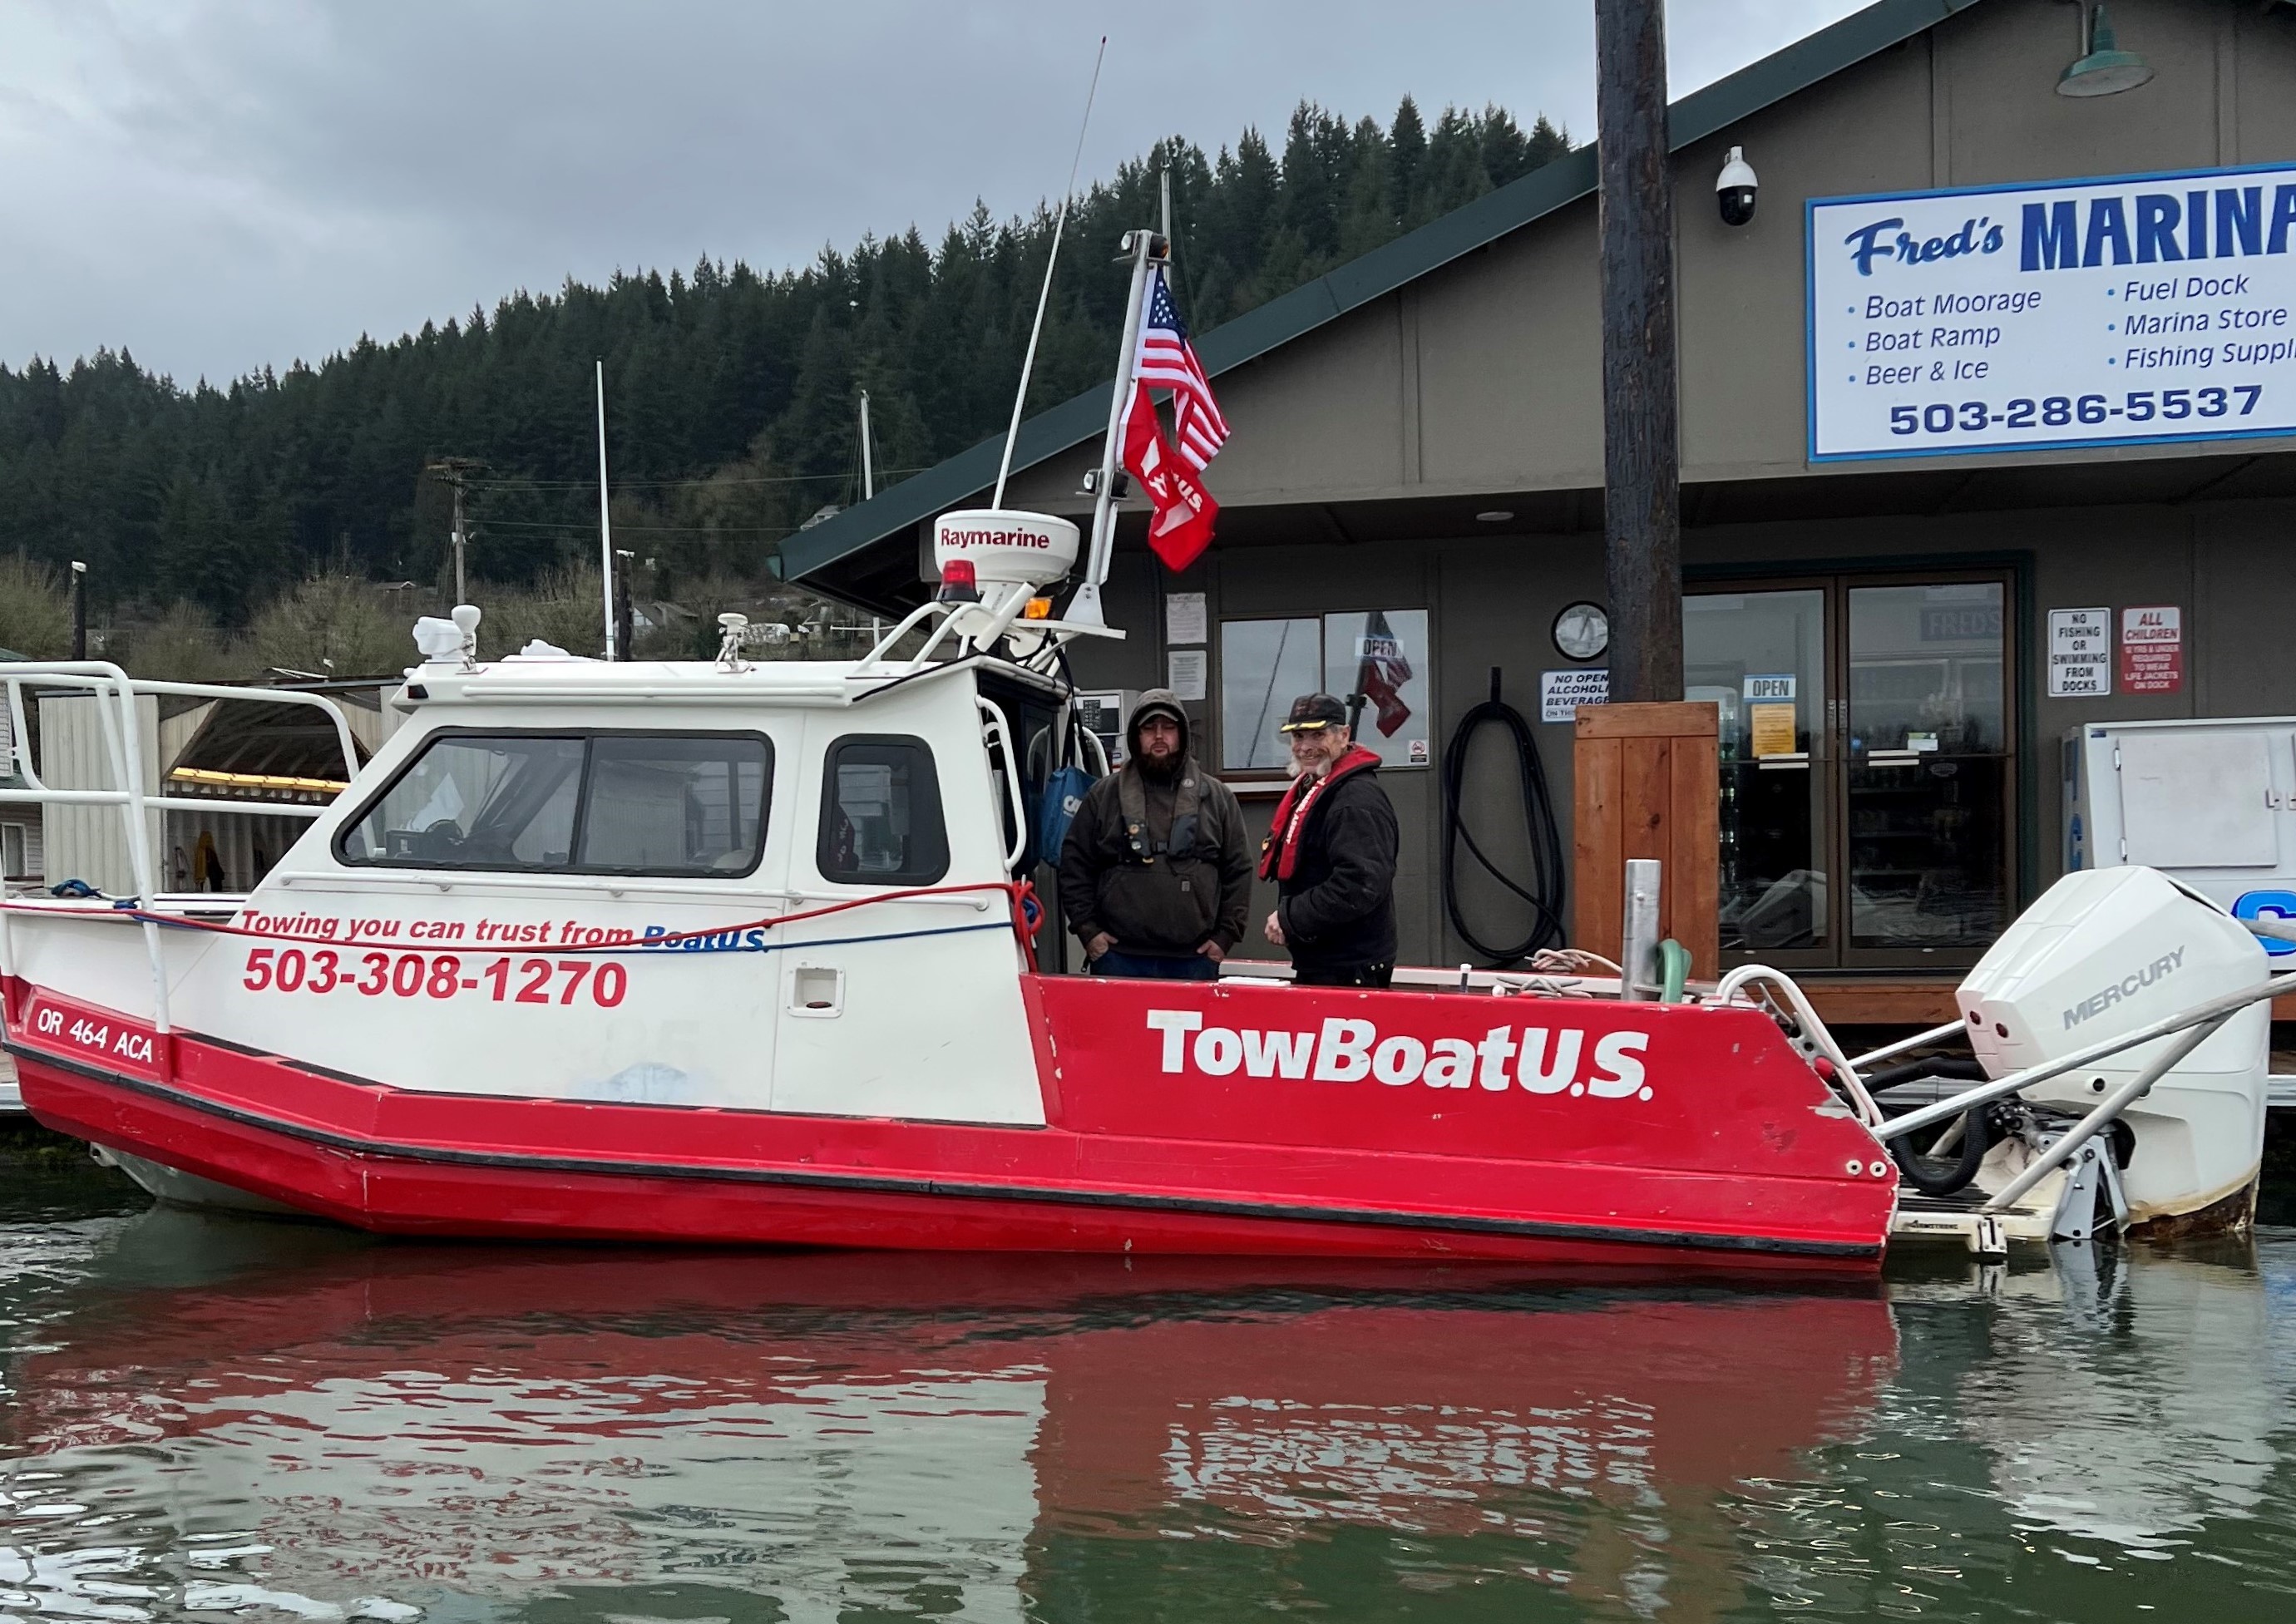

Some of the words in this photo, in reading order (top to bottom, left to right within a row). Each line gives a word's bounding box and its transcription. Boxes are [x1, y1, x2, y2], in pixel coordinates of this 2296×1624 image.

[1844, 216, 2003, 276] Fred's
[2021, 185, 2296, 272] MARINA
[2125, 278, 2178, 301] Fuel
[2186, 274, 2249, 298] Dock
[1865, 294, 1925, 319] Boat
[1933, 291, 2042, 313] Moorage
[2125, 312, 2210, 335] Marina
[2218, 308, 2287, 329] Store
[1865, 328, 1923, 352] Boat
[1930, 326, 2000, 348] Ramp
[2126, 345, 2214, 368] Fishing
[2222, 338, 2296, 366] Suppl
[1865, 364, 1923, 385] Beer
[1930, 361, 1945, 381] &
[1954, 359, 1988, 379] Ice
[1890, 385, 2263, 435] 503-286-5537
[941, 527, 1050, 549] Raymarine
[2059, 626, 2100, 638] FISHING
[2071, 614, 2086, 624] NO
[2139, 612, 2163, 626] ALL
[2072, 639, 2086, 650] OR
[2126, 628, 2179, 640] CHILDREN
[1363, 639, 1397, 657] OPEN
[2052, 653, 2106, 664] SWIMMING
[1555, 675, 1573, 684] NO
[1577, 674, 1609, 683] OPEN
[2062, 680, 2096, 691] DOCKS
[2066, 667, 2094, 678] FROM
[1752, 679, 1789, 697] OPEN
[242, 911, 339, 940] Towing
[344, 918, 401, 942] you
[409, 920, 466, 940] can
[476, 918, 551, 943] trust
[560, 921, 634, 945] from
[243, 948, 627, 1008] 503-308-1270
[2063, 945, 2185, 1031] MERCURY
[37, 1008, 64, 1036] OR
[69, 1019, 109, 1049] 464
[112, 1031, 152, 1063] ACA
[1147, 1009, 1654, 1102] TowBoatU.S.
